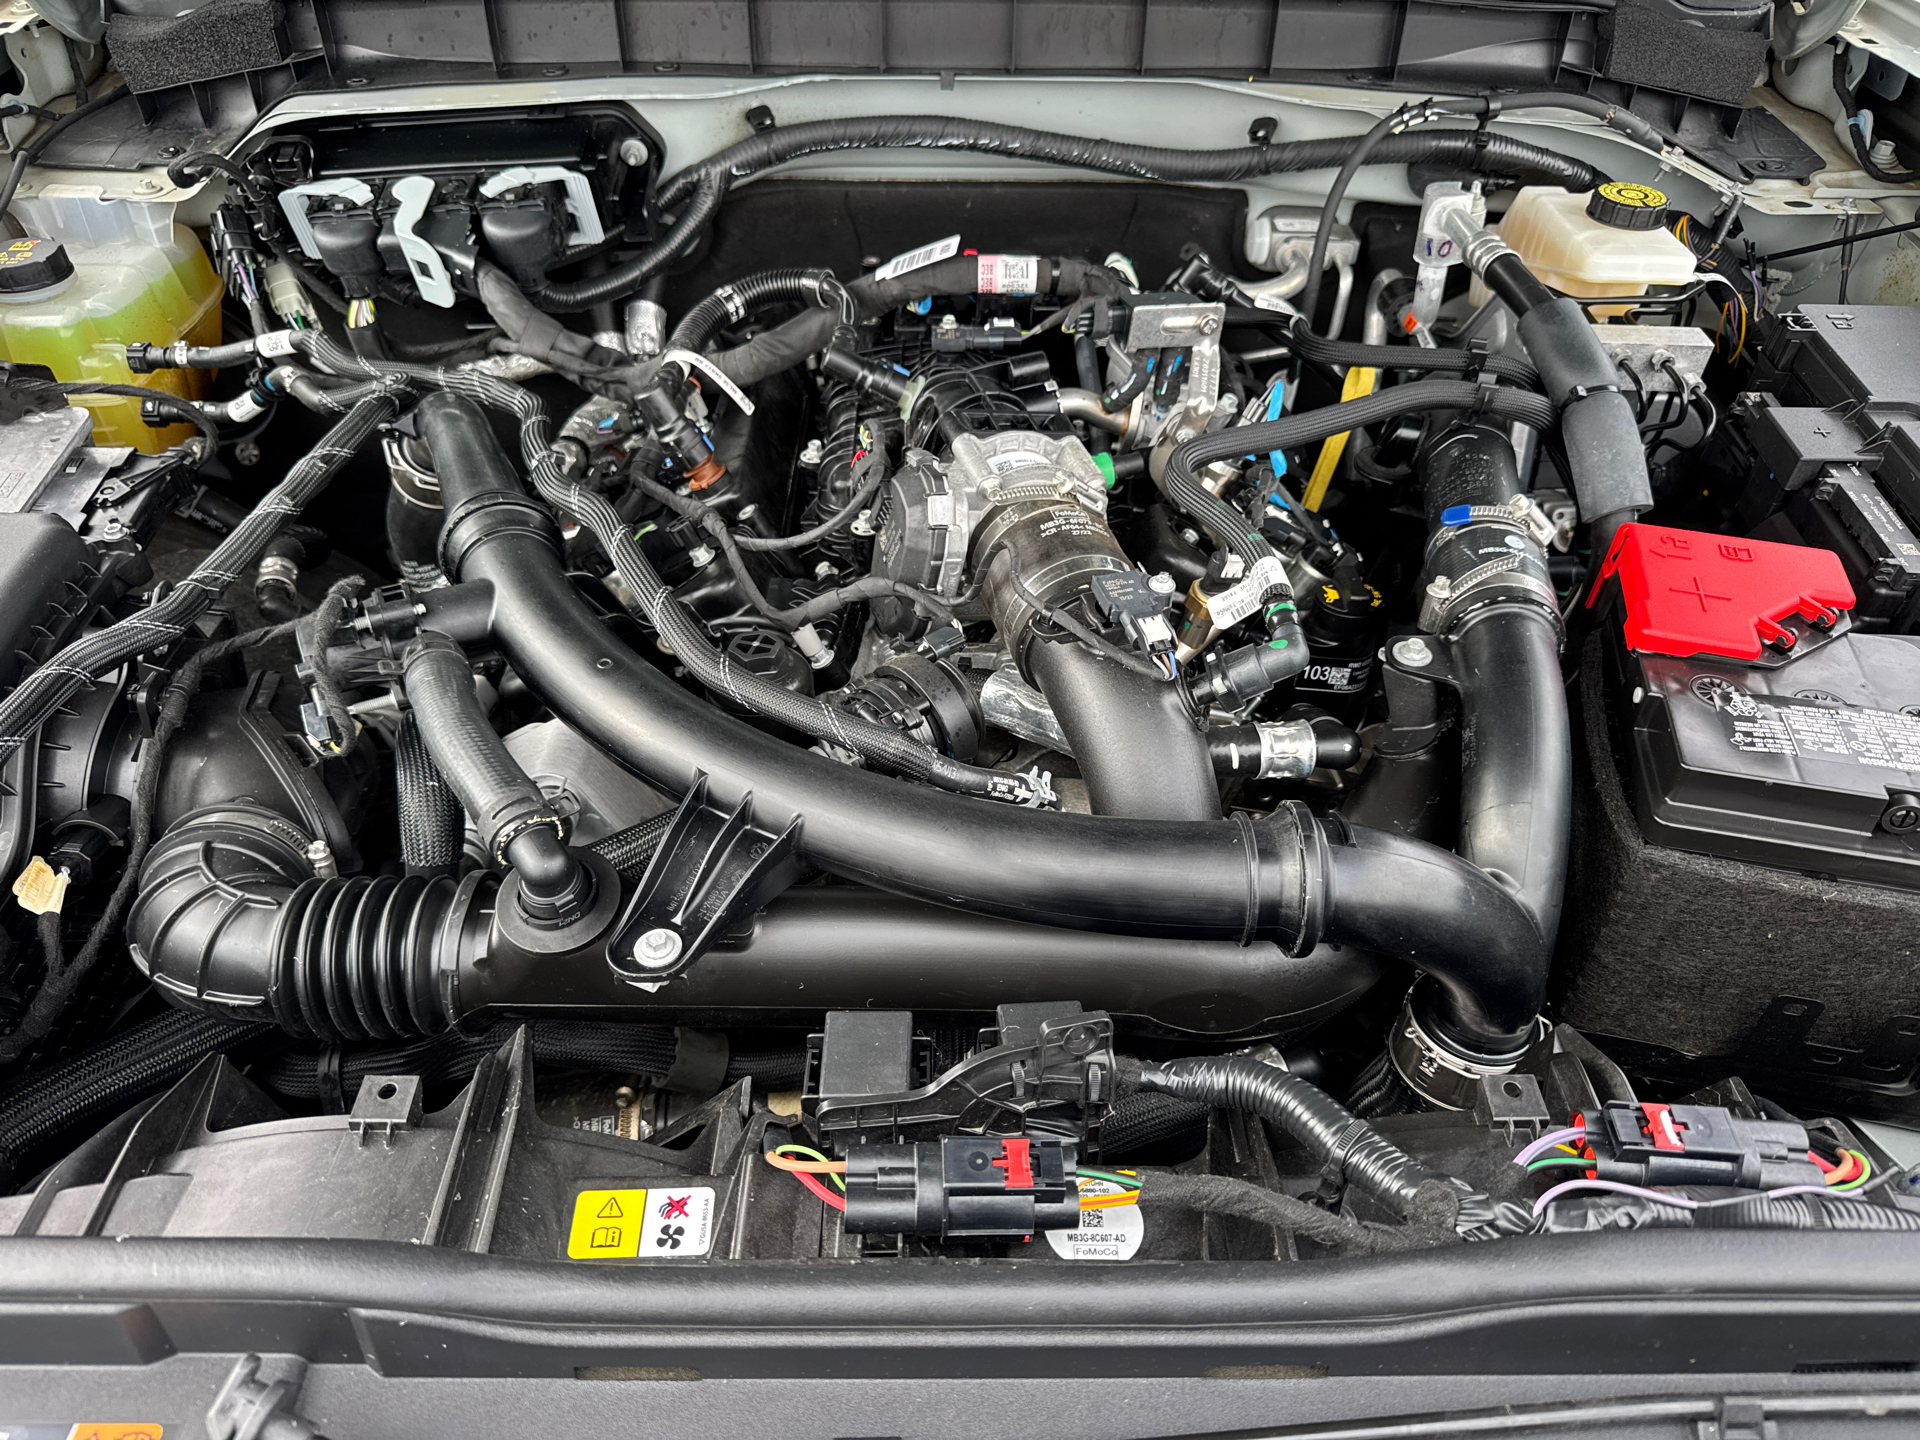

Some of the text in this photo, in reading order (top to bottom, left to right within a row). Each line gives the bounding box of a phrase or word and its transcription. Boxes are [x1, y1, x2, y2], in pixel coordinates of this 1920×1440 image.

[1303, 665, 1331, 681] 103
[996, 784, 1009, 793] ENG
[1067, 1233, 1126, 1243] MB3G-8C607-AD
[1076, 1247, 1118, 1256] FoMoCo
